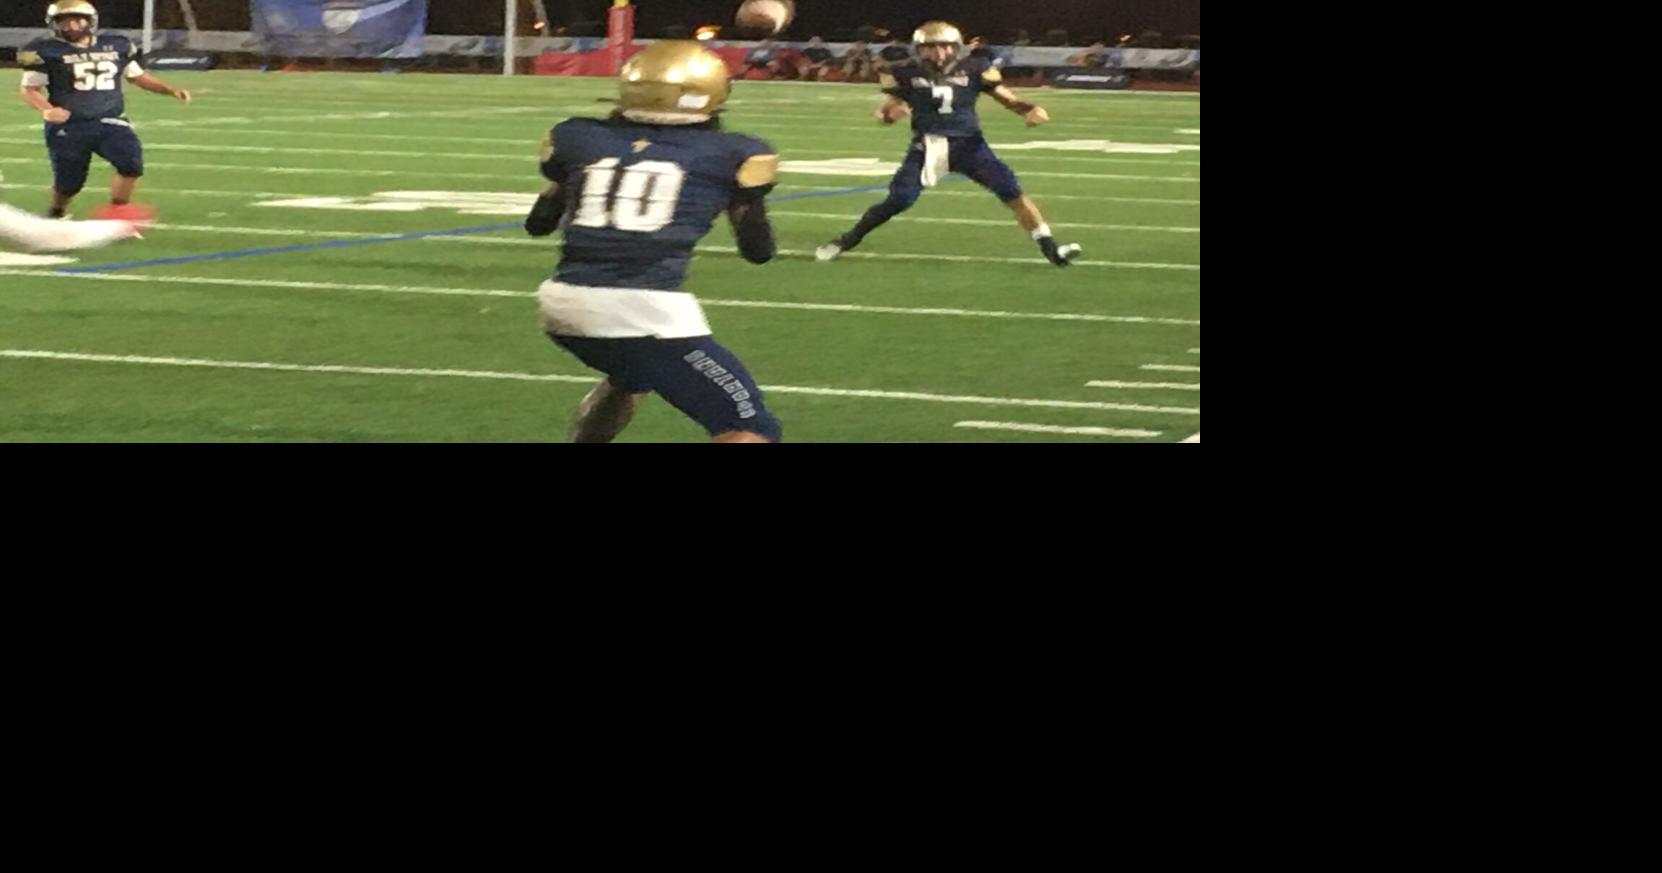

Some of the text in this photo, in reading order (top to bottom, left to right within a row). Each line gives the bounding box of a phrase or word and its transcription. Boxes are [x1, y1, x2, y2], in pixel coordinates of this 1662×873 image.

[73, 60, 119, 91] 52
[932, 86, 954, 115] 7
[571, 156, 687, 233] 10
